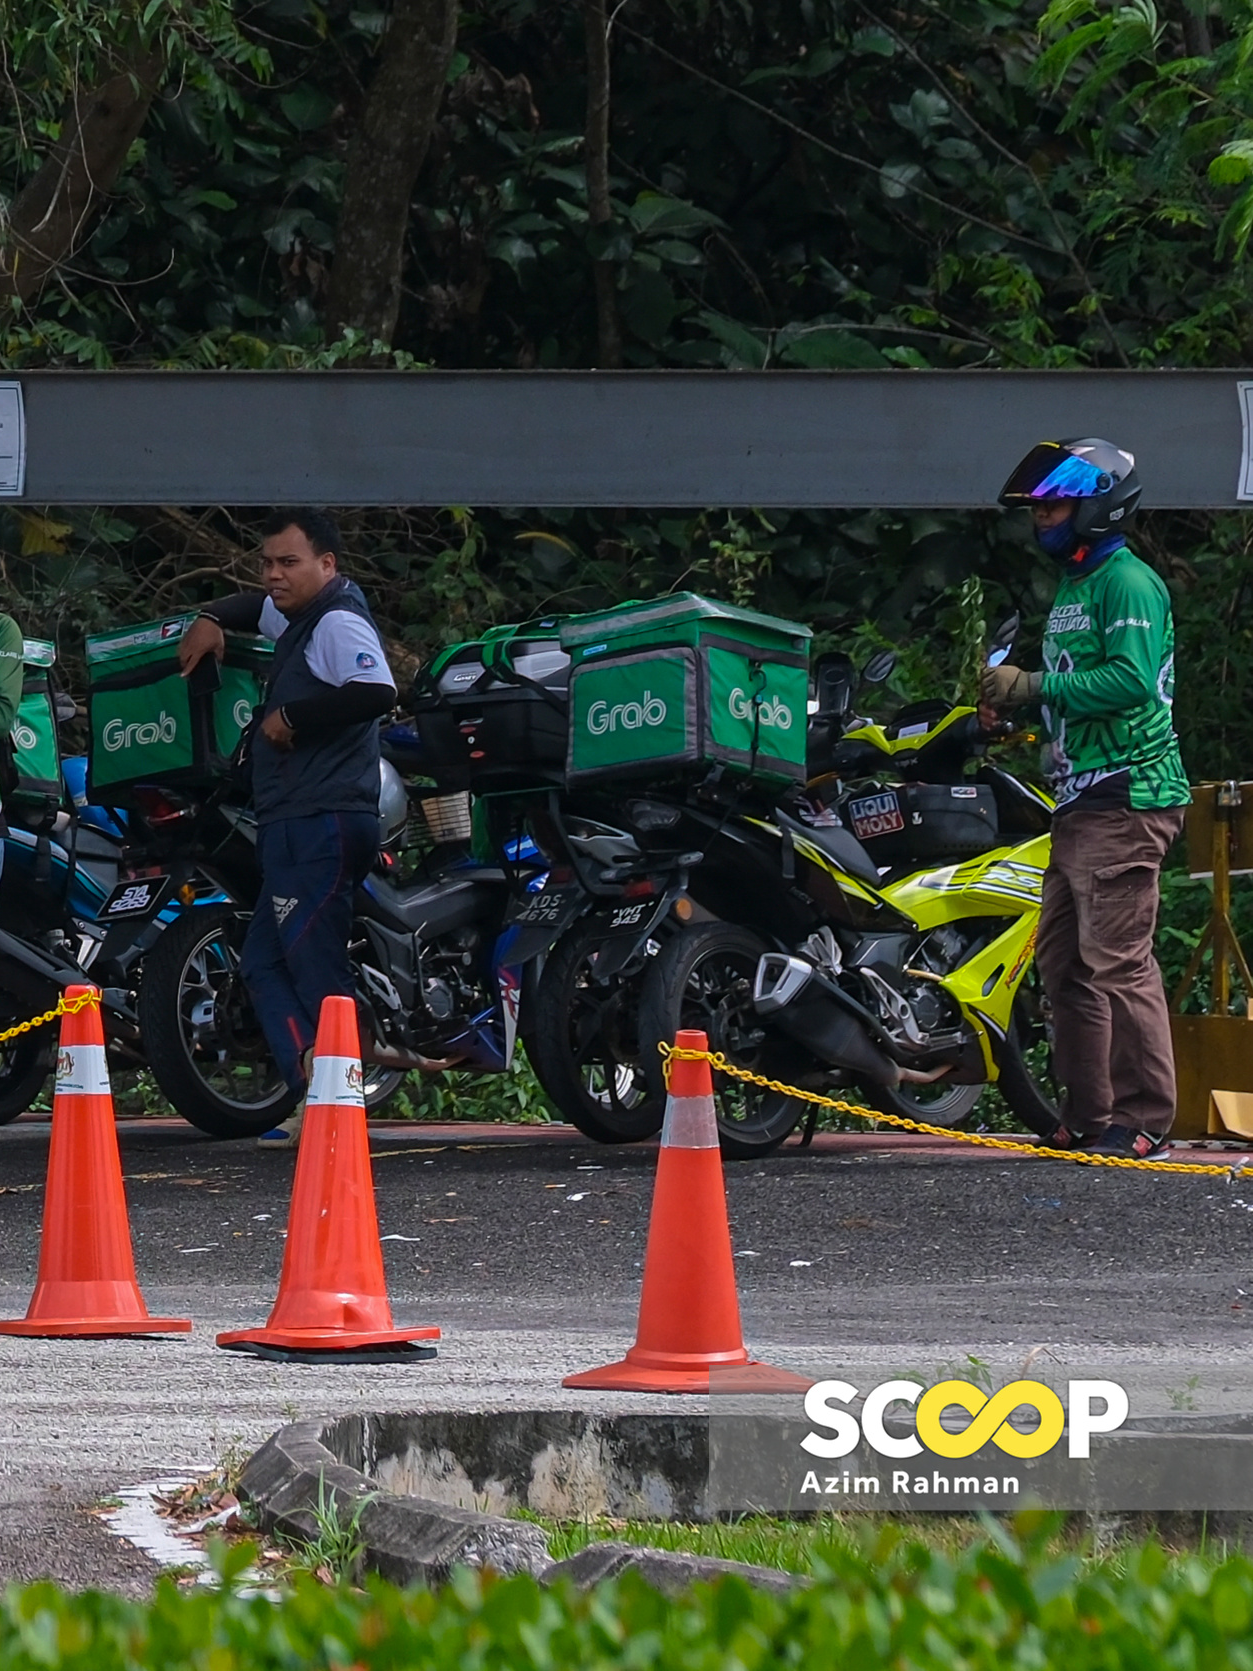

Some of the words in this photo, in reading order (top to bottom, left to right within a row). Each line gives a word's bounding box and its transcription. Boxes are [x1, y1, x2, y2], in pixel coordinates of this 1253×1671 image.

[587, 690, 667, 735] Grab
[728, 687, 792, 730] Grab
[103, 710, 177, 752] Grab
[852, 794, 896, 820] LIQUI
[856, 811, 899, 836] MOLY
[516, 908, 560, 921] 4676
[529, 894, 563, 909] KDS
